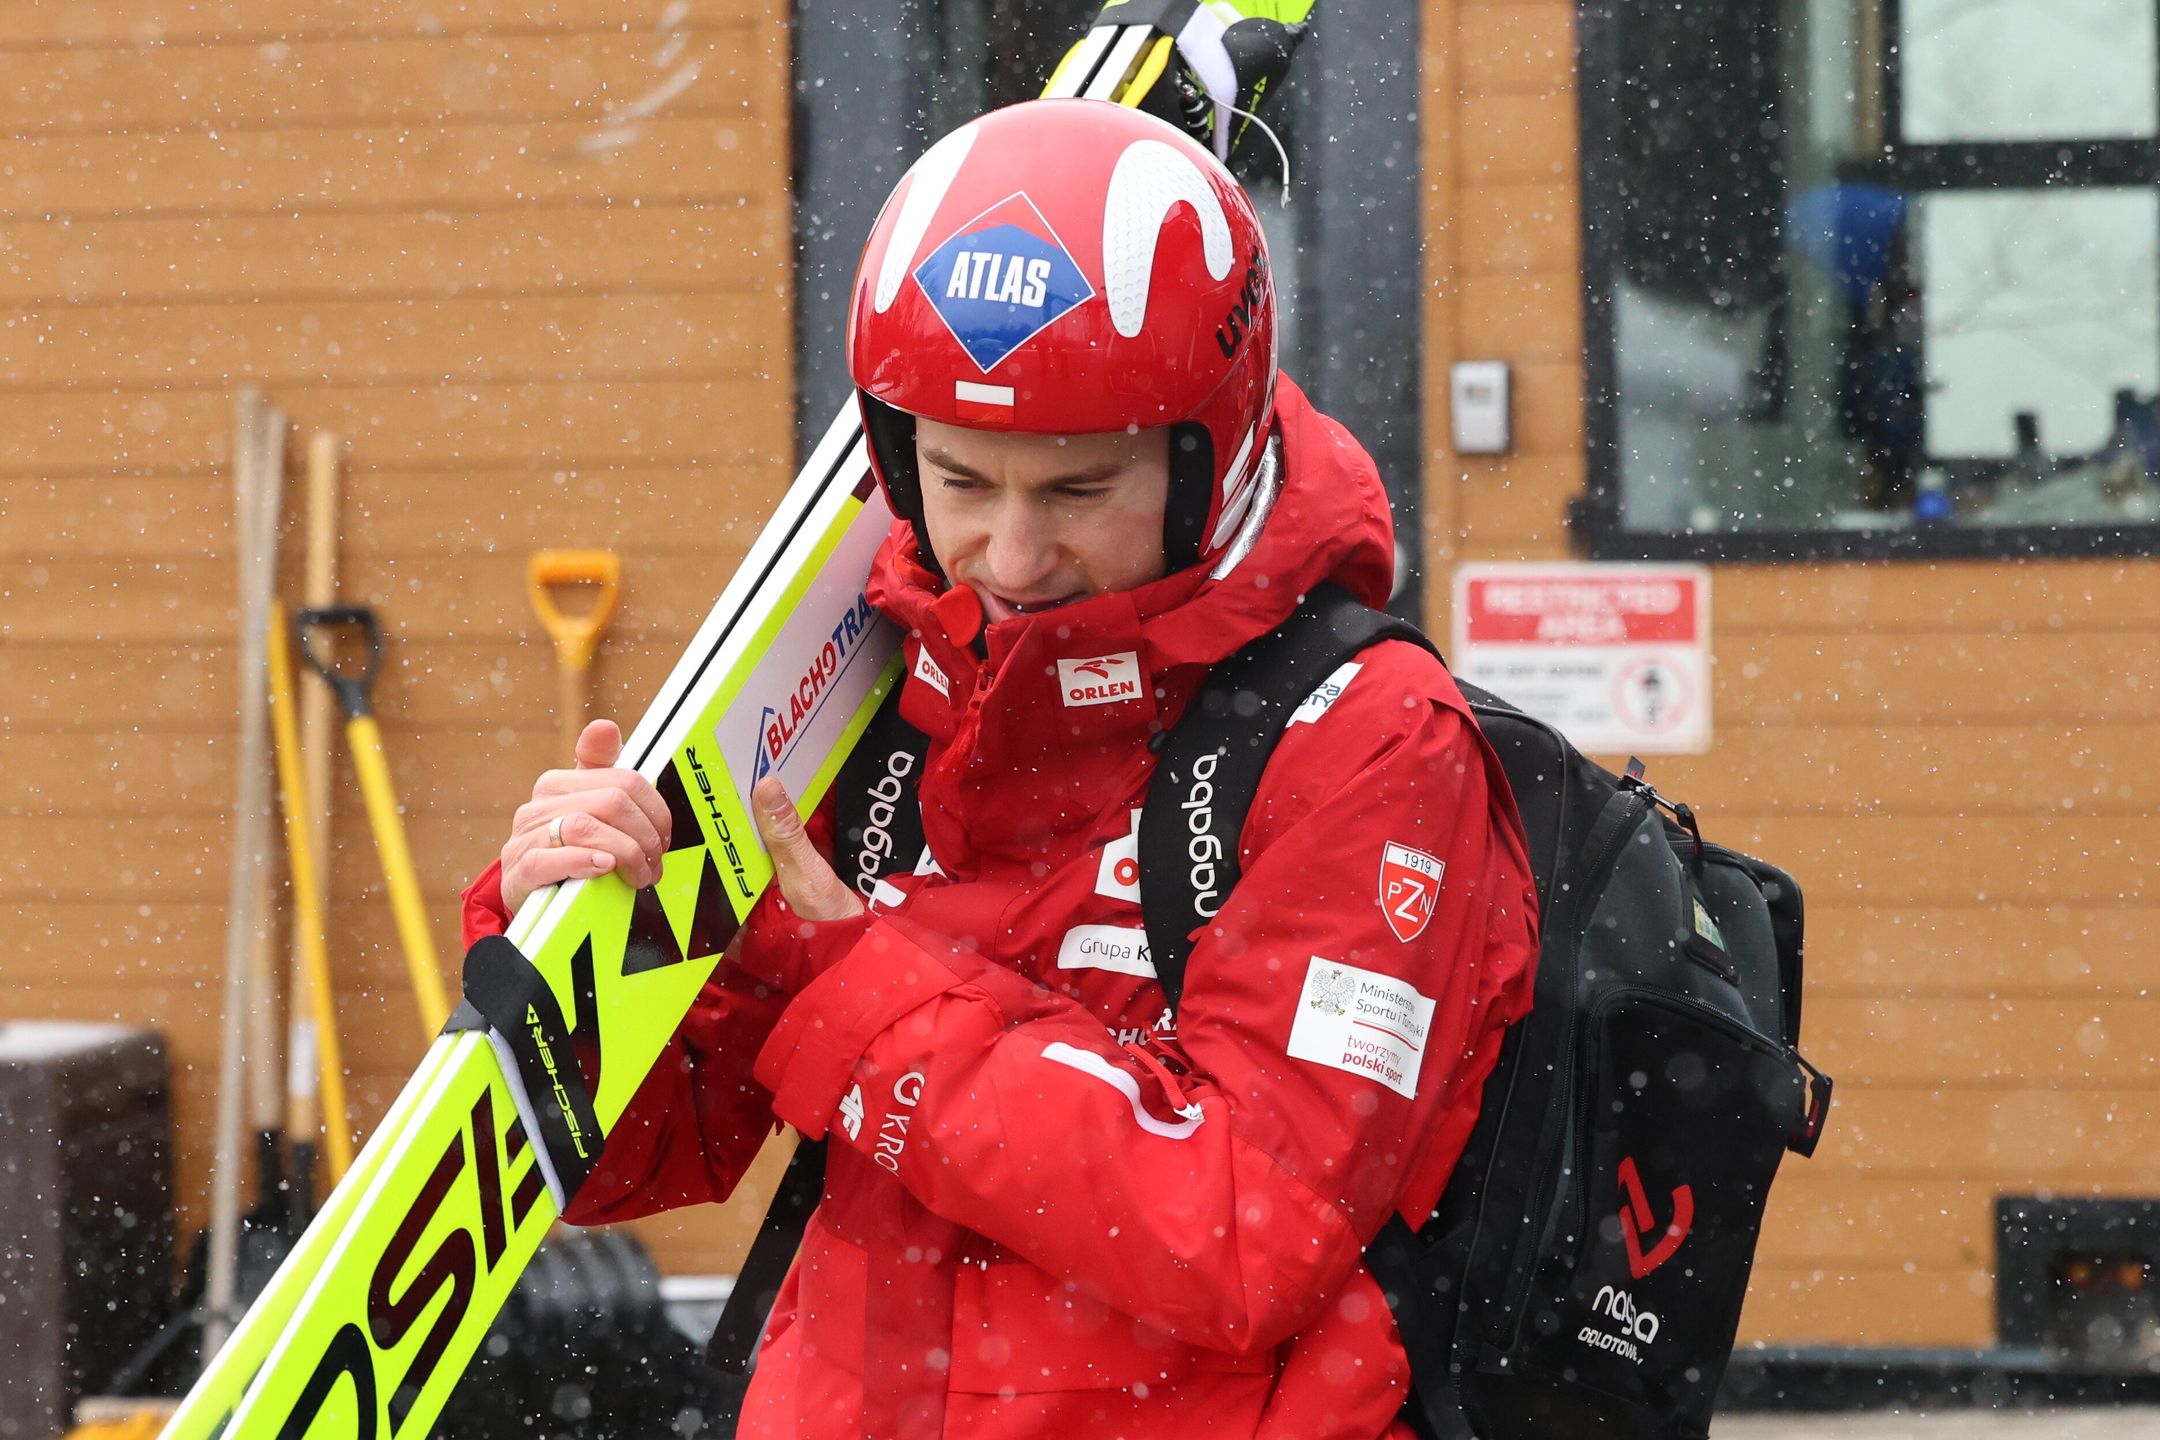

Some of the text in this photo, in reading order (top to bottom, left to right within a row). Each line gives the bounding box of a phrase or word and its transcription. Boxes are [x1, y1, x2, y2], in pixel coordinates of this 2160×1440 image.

[946, 252, 1051, 308] ATLAS
[766, 592, 877, 761] BLACHOTRA
[1069, 681, 1135, 702] ORLEN
[686, 745, 755, 899] FISCHER
[857, 750, 915, 898] nagaba
[1181, 754, 1223, 917] nagaba
[1403, 852, 1432, 874] 1919
[1080, 937, 1152, 963] Grupa K
[1356, 998, 1397, 1021] Sportu
[1342, 1051, 1403, 1085] polski sport
[1347, 1035, 1402, 1067] tworzymy
[532, 1024, 589, 1159] FISCHER
[873, 1113, 911, 1177] KRO
